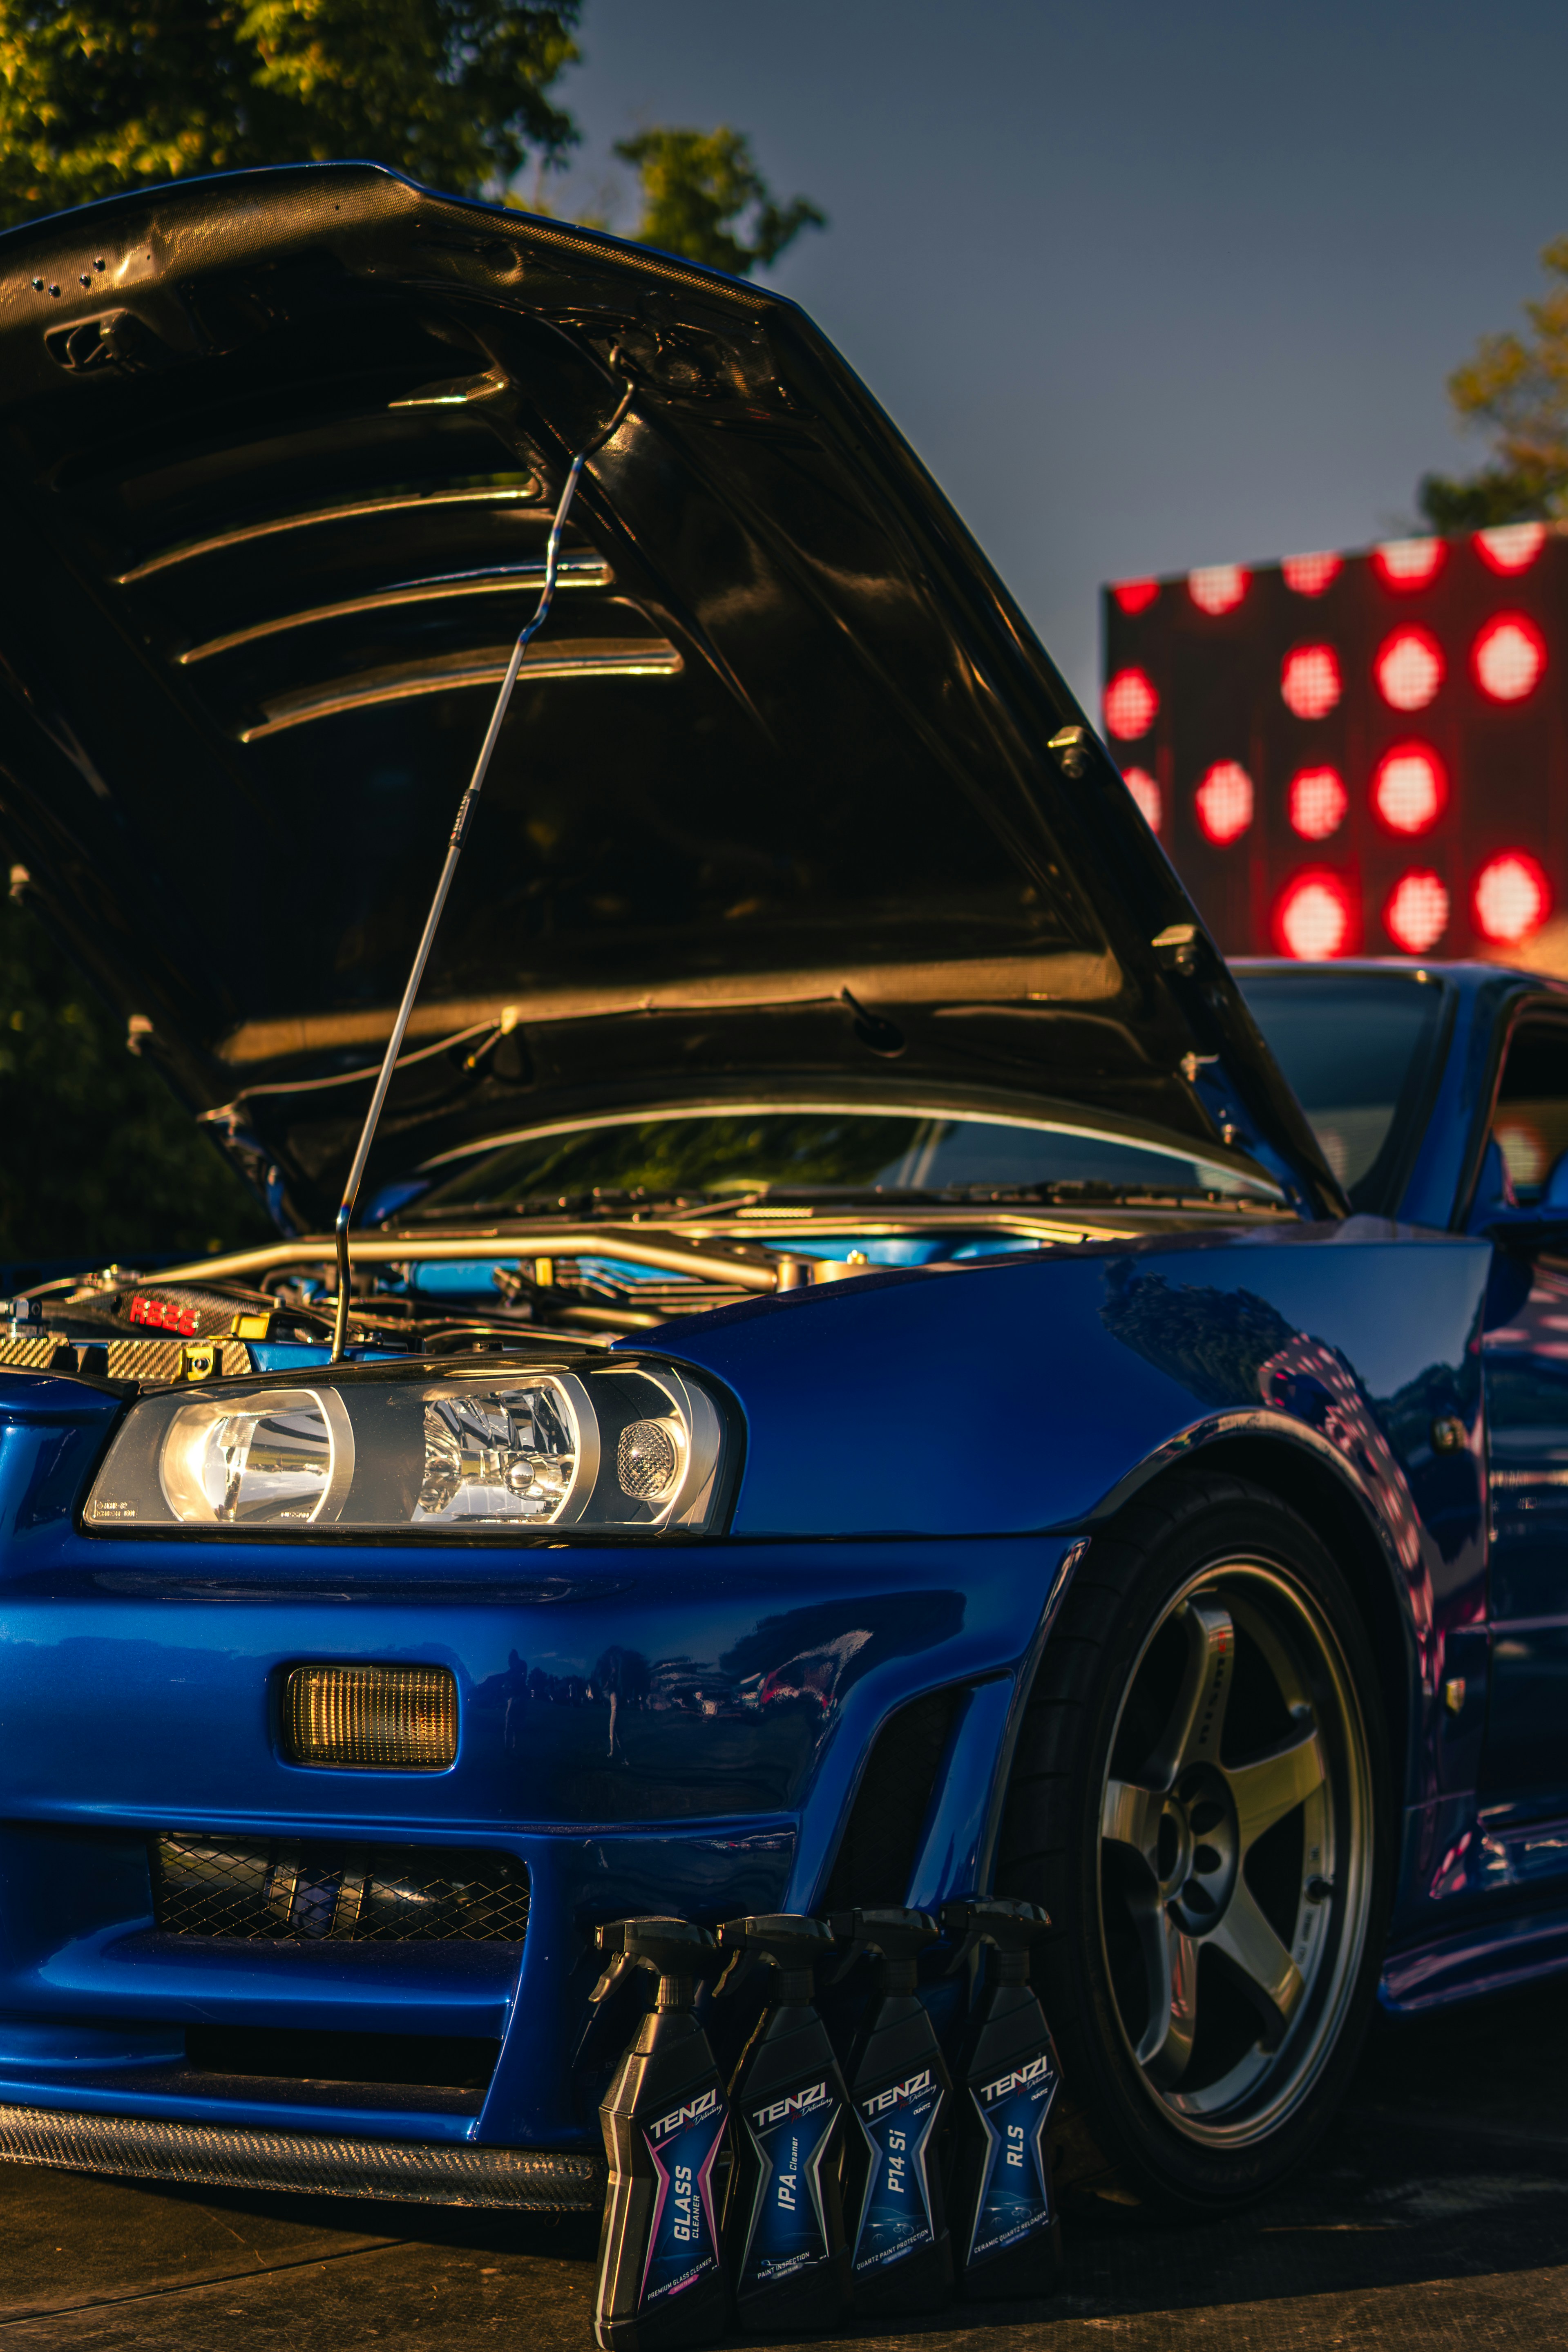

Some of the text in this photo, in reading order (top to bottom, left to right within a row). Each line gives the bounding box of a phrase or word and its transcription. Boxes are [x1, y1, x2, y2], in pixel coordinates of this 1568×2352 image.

[130, 1296, 201, 1336] RB26
[862, 2069, 930, 2115] TENZI
[981, 2055, 1047, 2102] TENZI
[650, 2088, 716, 2139] TENZI
[753, 2082, 826, 2127] TENZI
[888, 2129, 906, 2193] P14 Si
[1007, 2125, 1024, 2168] RLS
[778, 2137, 798, 2211] IPA Cleaner
[674, 2165, 692, 2241] GLASS
[692, 2195, 700, 2238] CLEANER
[857, 2254, 879, 2270] QUARTZ
[880, 2246, 896, 2259] PAINT
[896, 2229, 929, 2250] PROTECTION
[974, 2237, 998, 2254] CERAMIC
[999, 2226, 1020, 2242] QUARTZ
[1021, 2211, 1046, 2230] RELOADER
[648, 2257, 712, 2301] PREMIUM GLASS CLEANER
[757, 2251, 810, 2279] PAINT INSPECTION
